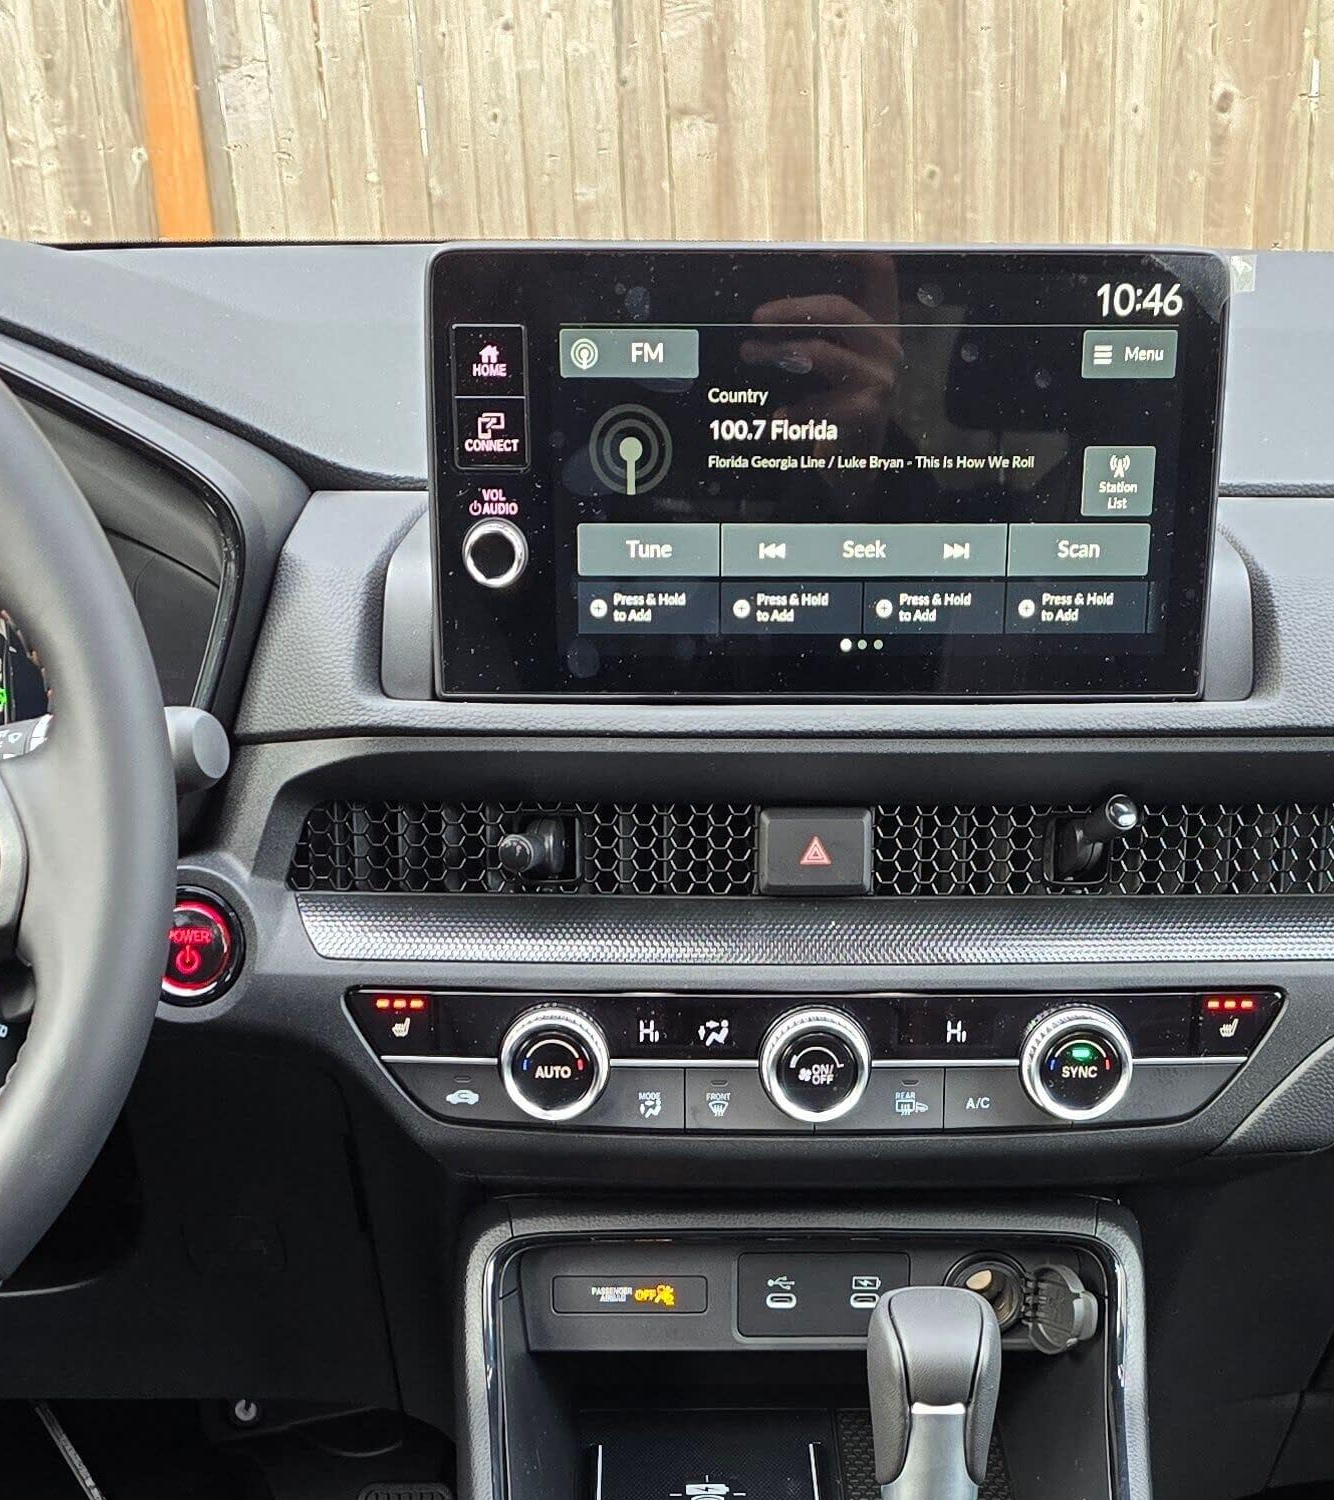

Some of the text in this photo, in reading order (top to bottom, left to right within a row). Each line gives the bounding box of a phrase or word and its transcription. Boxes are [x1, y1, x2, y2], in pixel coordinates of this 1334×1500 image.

[1096, 283, 1183, 317] 10:46
[631, 342, 664, 363] FM
[1124, 346, 1164, 362] Menu
[472, 363, 507, 377] HOME
[708, 387, 769, 405] Country
[709, 419, 838, 440] 100.7 Florida
[464, 439, 519, 452] CONNECT
[708, 455, 748, 468] Florida
[751, 455, 798, 471] Georgia
[800, 455, 826, 468] Line
[837, 456, 866, 469] Luke
[869, 456, 904, 471] Bryan
[915, 456, 940, 469] This
[942, 456, 953, 469] Is
[956, 456, 985, 469] How
[987, 456, 1009, 469] We
[1011, 456, 1035, 469] Roll
[1099, 481, 1138, 493] Station
[482, 488, 506, 501] VOL
[482, 502, 518, 515] AUDIO
[1107, 497, 1127, 509] List
[625, 540, 672, 558] Tune
[843, 540, 886, 559] Seek
[1057, 540, 1100, 559] Scan
[613, 593, 686, 606] Press & Hold
[756, 593, 829, 606] Press & Hold
[899, 593, 971, 606] Press & Hold
[1042, 593, 1114, 606] Press & Hold
[613, 609, 652, 622] to Add
[756, 609, 794, 622] to Add
[899, 609, 937, 622] to Add
[1041, 609, 1079, 622] to Add
[535, 1066, 572, 1079] AUTO
[1061, 1066, 1098, 1079] SYNC
[811, 1075, 835, 1086] OFF
[638, 1092, 661, 1101] MODE
[706, 1092, 731, 1101] FRONT
[895, 1092, 916, 1100] REAR
[966, 1097, 990, 1109] A/C
[634, 1288, 657, 1301] OFF
